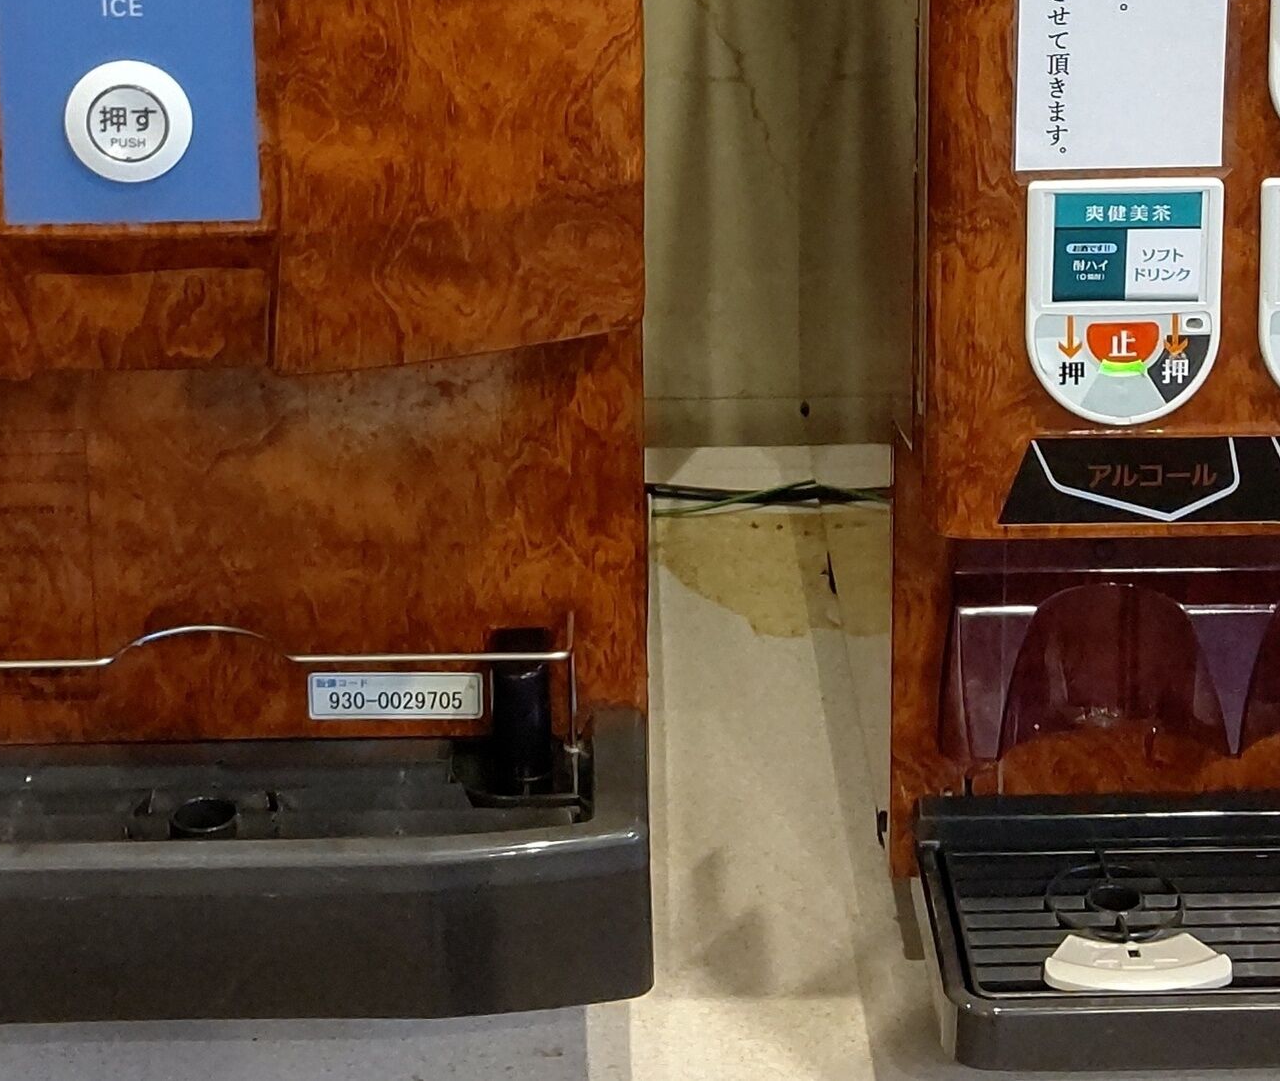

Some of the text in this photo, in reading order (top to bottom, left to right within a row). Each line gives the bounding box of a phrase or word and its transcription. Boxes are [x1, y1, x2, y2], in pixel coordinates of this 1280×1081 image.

[99, 106, 158, 133] 押す
[110, 137, 147, 149] PUSH
[1085, 205, 1172, 222] 爽健美茶
[1142, 248, 1184, 263] ソフト
[1073, 260, 1109, 271] 酎ハイ
[1134, 267, 1191, 282] ドリンク
[1109, 330, 1137, 357] 止
[1058, 361, 1085, 386] 押
[1161, 358, 1190, 385] 押
[1088, 463, 1217, 488] アルコール
[329, 692, 463, 710] 930-0029705
